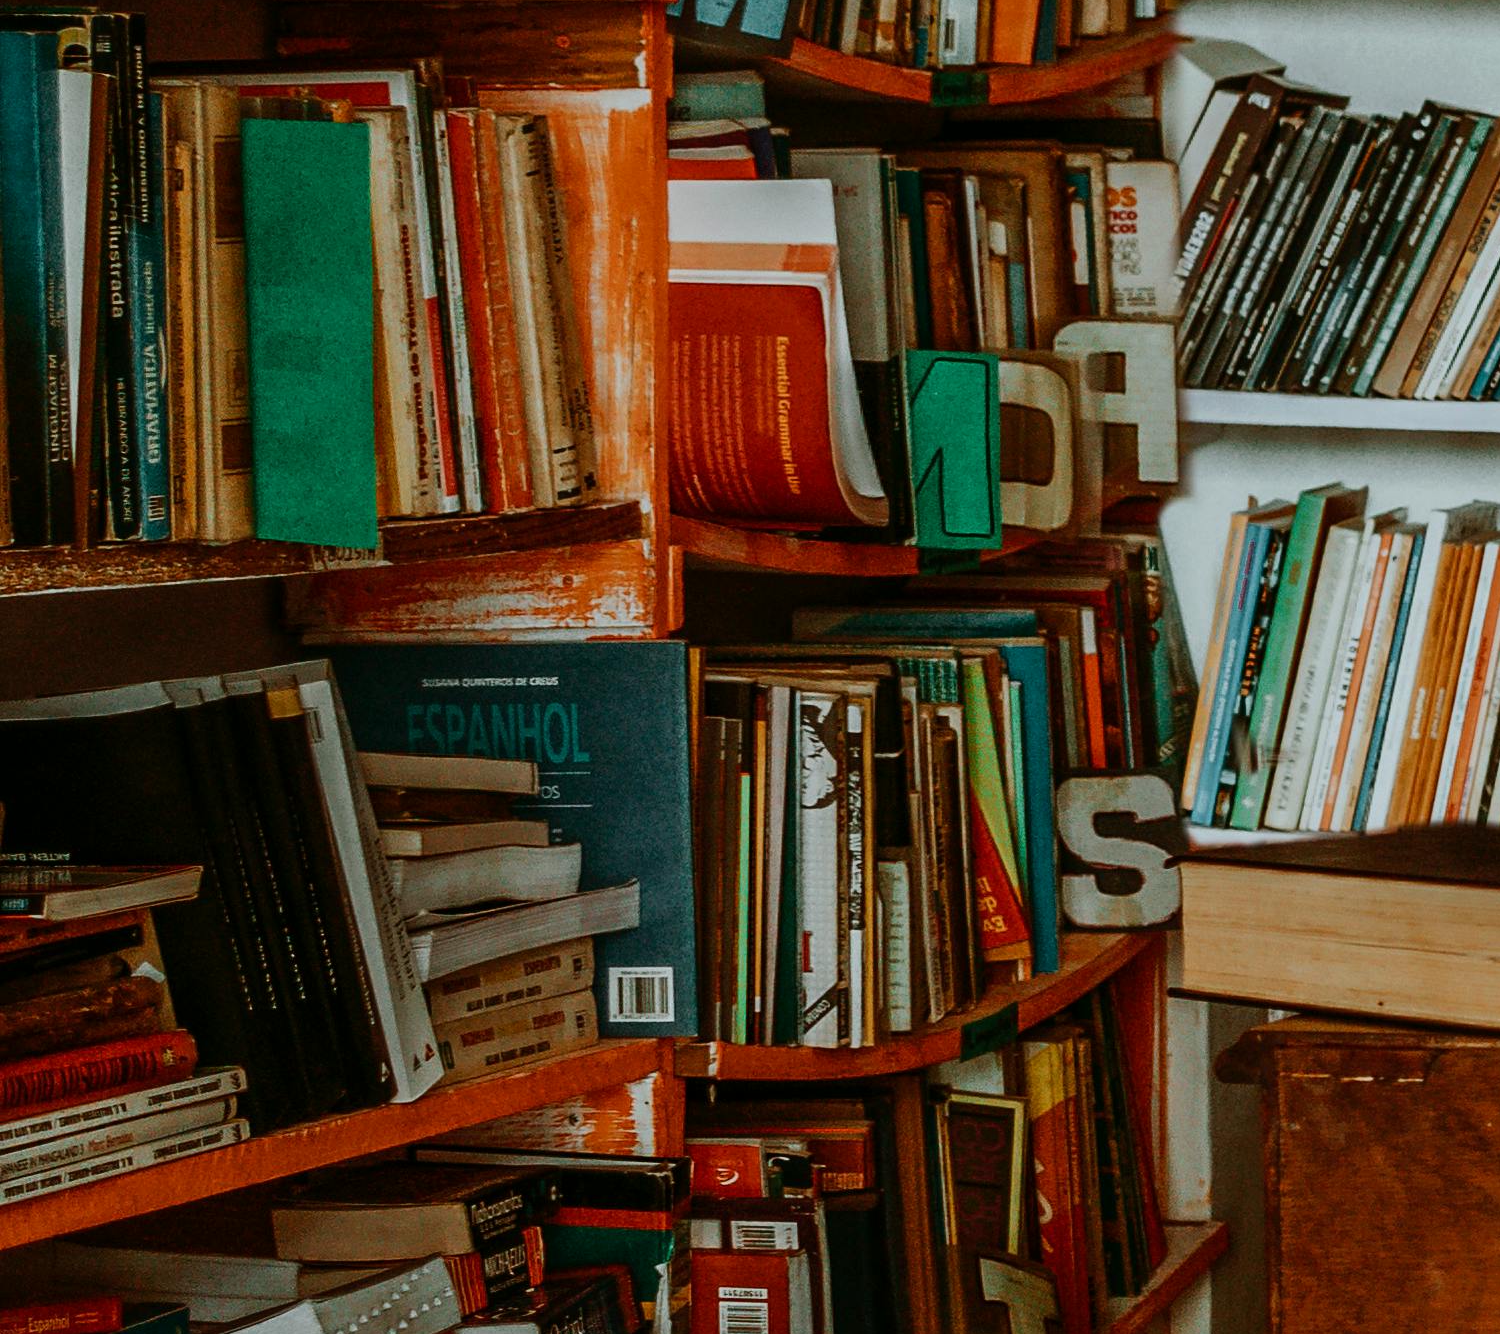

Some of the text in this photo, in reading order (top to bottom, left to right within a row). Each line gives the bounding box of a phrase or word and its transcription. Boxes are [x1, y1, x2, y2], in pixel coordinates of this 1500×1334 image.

[110, 220, 123, 319] ilustrada
[47, 354, 61, 466] LINGUAGEM
[775, 334, 790, 400] Essential
[413, 381, 429, 481] Programa
[406, 702, 591, 764] ESPANHOL
[1056, 774, 1183, 928] S
[28, 1312, 70, 1334] Espanhol
